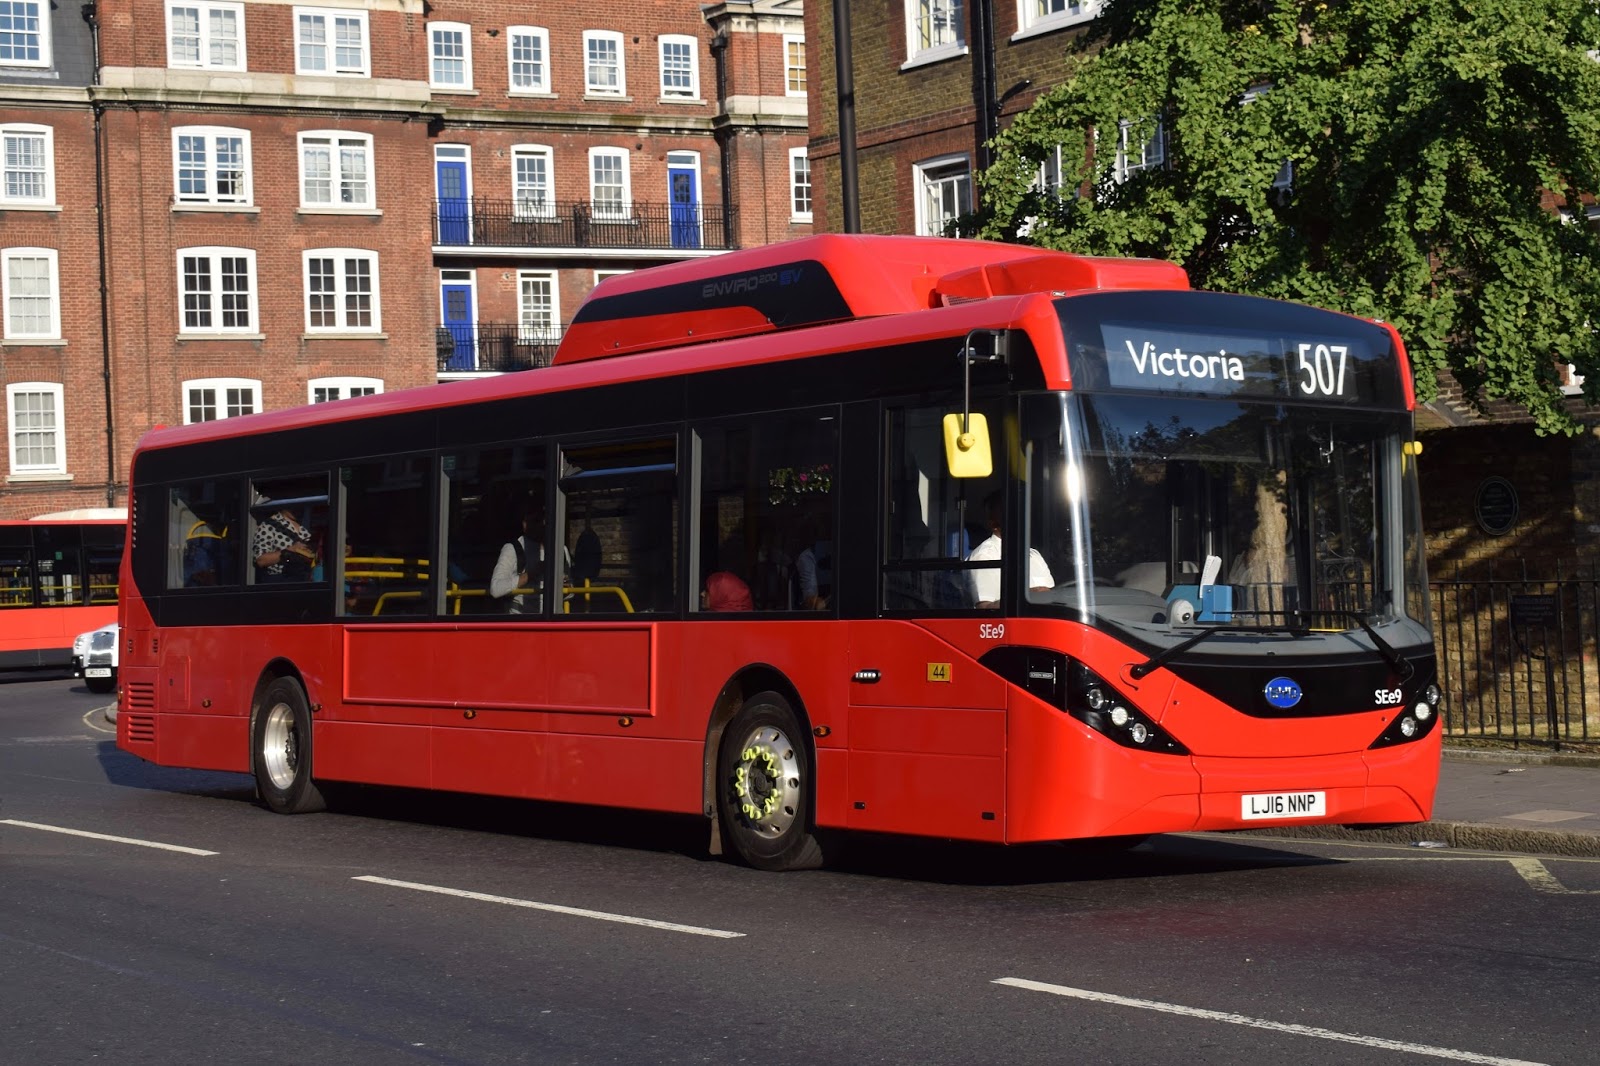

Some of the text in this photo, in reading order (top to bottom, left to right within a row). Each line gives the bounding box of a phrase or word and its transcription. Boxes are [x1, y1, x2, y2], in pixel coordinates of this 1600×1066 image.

[702, 268, 802, 298] ENVIRO 200 EV
[1125, 340, 1348, 395] Victoria 507
[979, 624, 1005, 639] SEe9
[933, 665, 946, 679] 44
[1374, 688, 1402, 705] SEe9
[1251, 794, 1316, 814] LJ16 NNP
